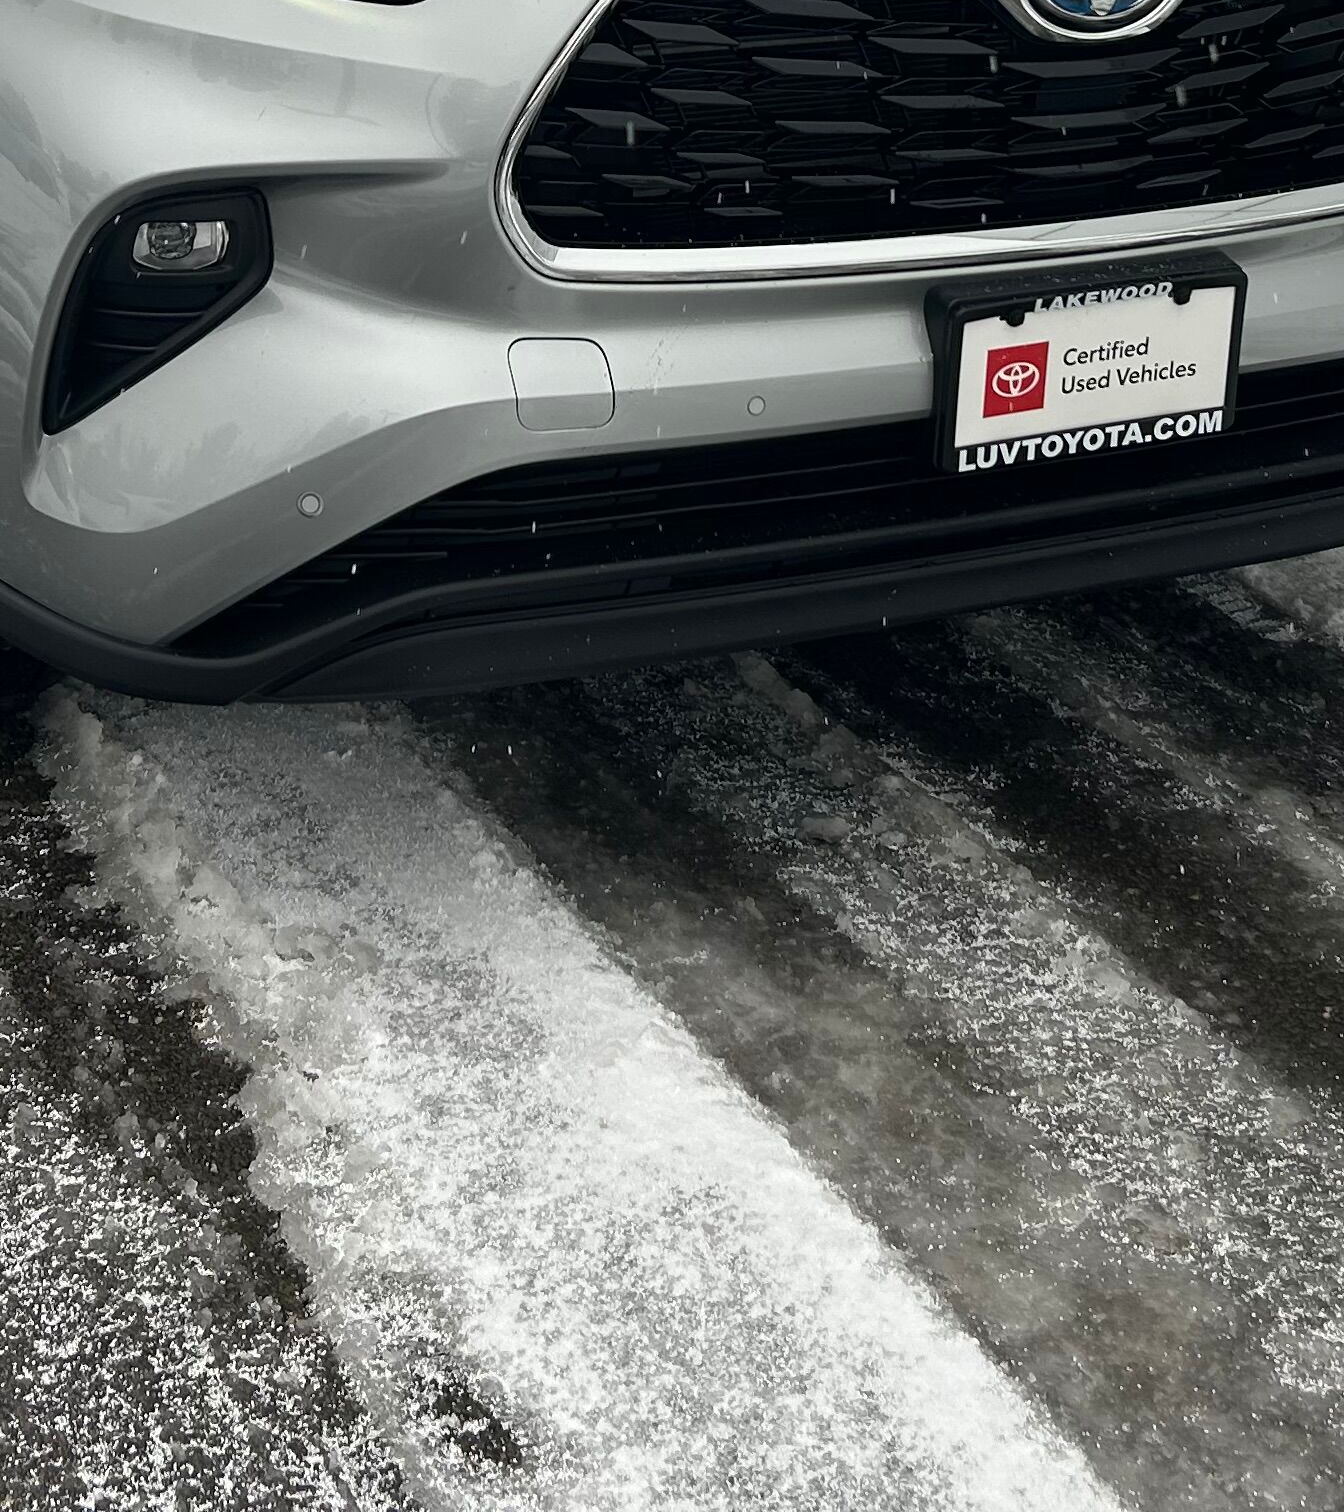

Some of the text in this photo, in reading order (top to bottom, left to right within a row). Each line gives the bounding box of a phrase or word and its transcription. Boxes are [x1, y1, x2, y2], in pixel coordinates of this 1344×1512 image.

[1033, 281, 1173, 313] LAKEWOOD
[1063, 336, 1149, 366] Certified
[1061, 360, 1197, 394] Used Vehicles
[958, 409, 1224, 473] LUVTOYOTA.COM
